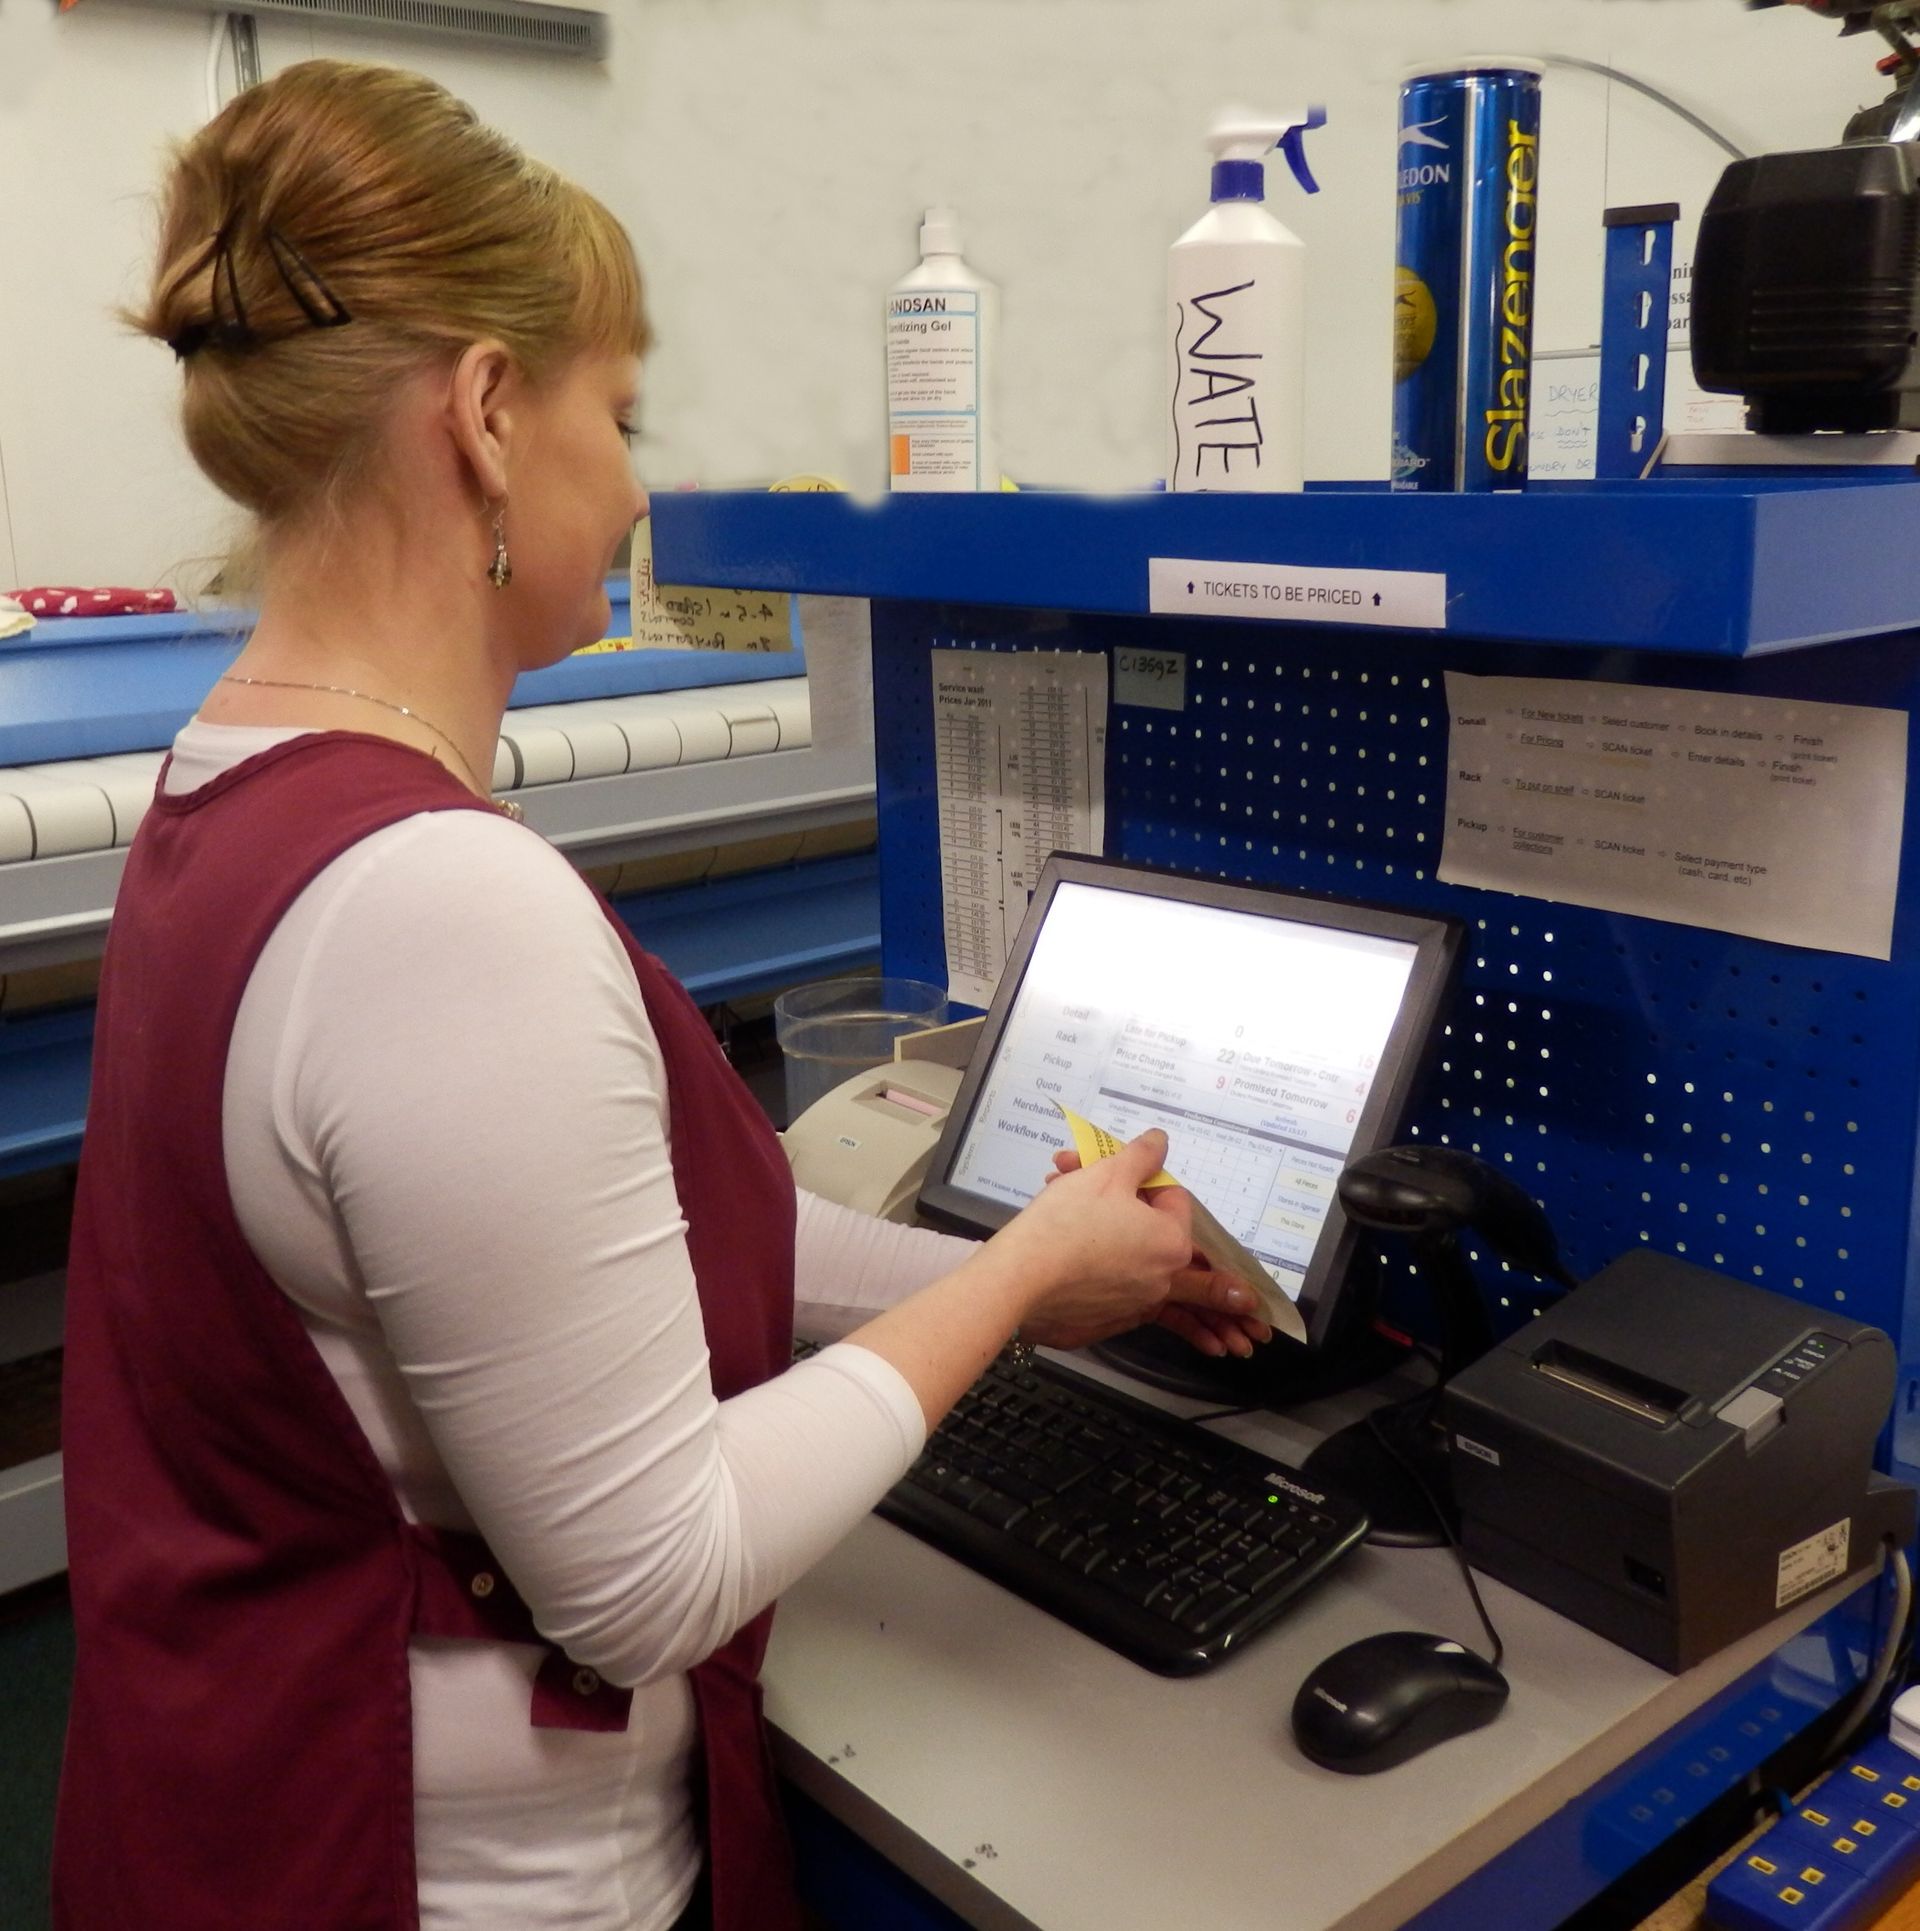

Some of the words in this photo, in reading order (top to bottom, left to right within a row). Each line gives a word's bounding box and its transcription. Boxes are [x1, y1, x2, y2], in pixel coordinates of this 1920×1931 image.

[888, 297, 946, 314] ANDSAN
[1484, 119, 1537, 473] Slazenger
[931, 320, 952, 332] Gel
[1187, 279, 1264, 491] WATE
[1204, 581, 1258, 599] TICKETS
[1262, 585, 1281, 600] TO
[1285, 587, 1303, 601] BE
[1308, 589, 1362, 606] PRICED
[939, 683, 966, 693] Service
[939, 695, 962, 704] Prices
[1521, 707, 1533, 719] For
[1535, 709, 1554, 721] New
[1555, 711, 1584, 724] tickets
[1601, 715, 1629, 728] Select
[1630, 720, 1670, 732] customer
[1695, 725, 1718, 738] Book
[1720, 728, 1729, 738] in
[1730, 729, 1763, 742] details
[1793, 735, 1824, 747] Finish
[1521, 733, 1533, 745] For
[1535, 735, 1564, 748] Pricing
[1601, 742, 1627, 755] SCAN
[1630, 747, 1653, 757] ticket
[1687, 752, 1712, 764] Enter
[1713, 755, 1745, 767] details
[1772, 760, 1802, 772] Finish
[1459, 771, 1481, 784] Rack
[1525, 781, 1541, 793] put
[1543, 783, 1554, 793] on
[1555, 783, 1574, 797] shelf
[1594, 788, 1620, 801] SCAN
[1621, 792, 1645, 804] ticket
[1457, 819, 1488, 833] Pickup
[1513, 827, 1526, 839] For
[1527, 830, 1564, 843] customer
[1594, 839, 1620, 852] SCAN
[1622, 843, 1645, 855] ticket
[1674, 851, 1701, 865] Select
[1704, 856, 1745, 872] payment
[1746, 861, 1767, 875] type
[1513, 840, 1553, 854] collections
[1678, 865, 1705, 880] (cash,
[1708, 869, 1731, 883] card,
[1733, 874, 1753, 887] etc)
[1063, 1006, 1089, 1020] Detail
[1056, 1030, 1078, 1044] Rack
[1157, 1032, 1187, 1047] Pickup
[1217, 1048, 1235, 1064] 22
[1043, 1053, 1072, 1069] Pickup
[1116, 1048, 1137, 1061] Price
[1138, 1053, 1175, 1071] Changes
[1216, 1076, 1226, 1089] 9
[1243, 1051, 1261, 1065] Due
[1265, 1057, 1312, 1076] Tomorrow
[1355, 1082, 1366, 1097] 4
[1036, 1078, 1062, 1093] Quote
[1012, 1097, 1067, 1120] Merchandise
[1234, 1078, 1278, 1097] Promised
[1280, 1089, 1328, 1110] Tomorrow
[1345, 1109, 1356, 1124] 6
[997, 1119, 1039, 1140] Workflow
[1040, 1132, 1065, 1148] Steps
[1264, 1472, 1326, 1505] Microsoft
